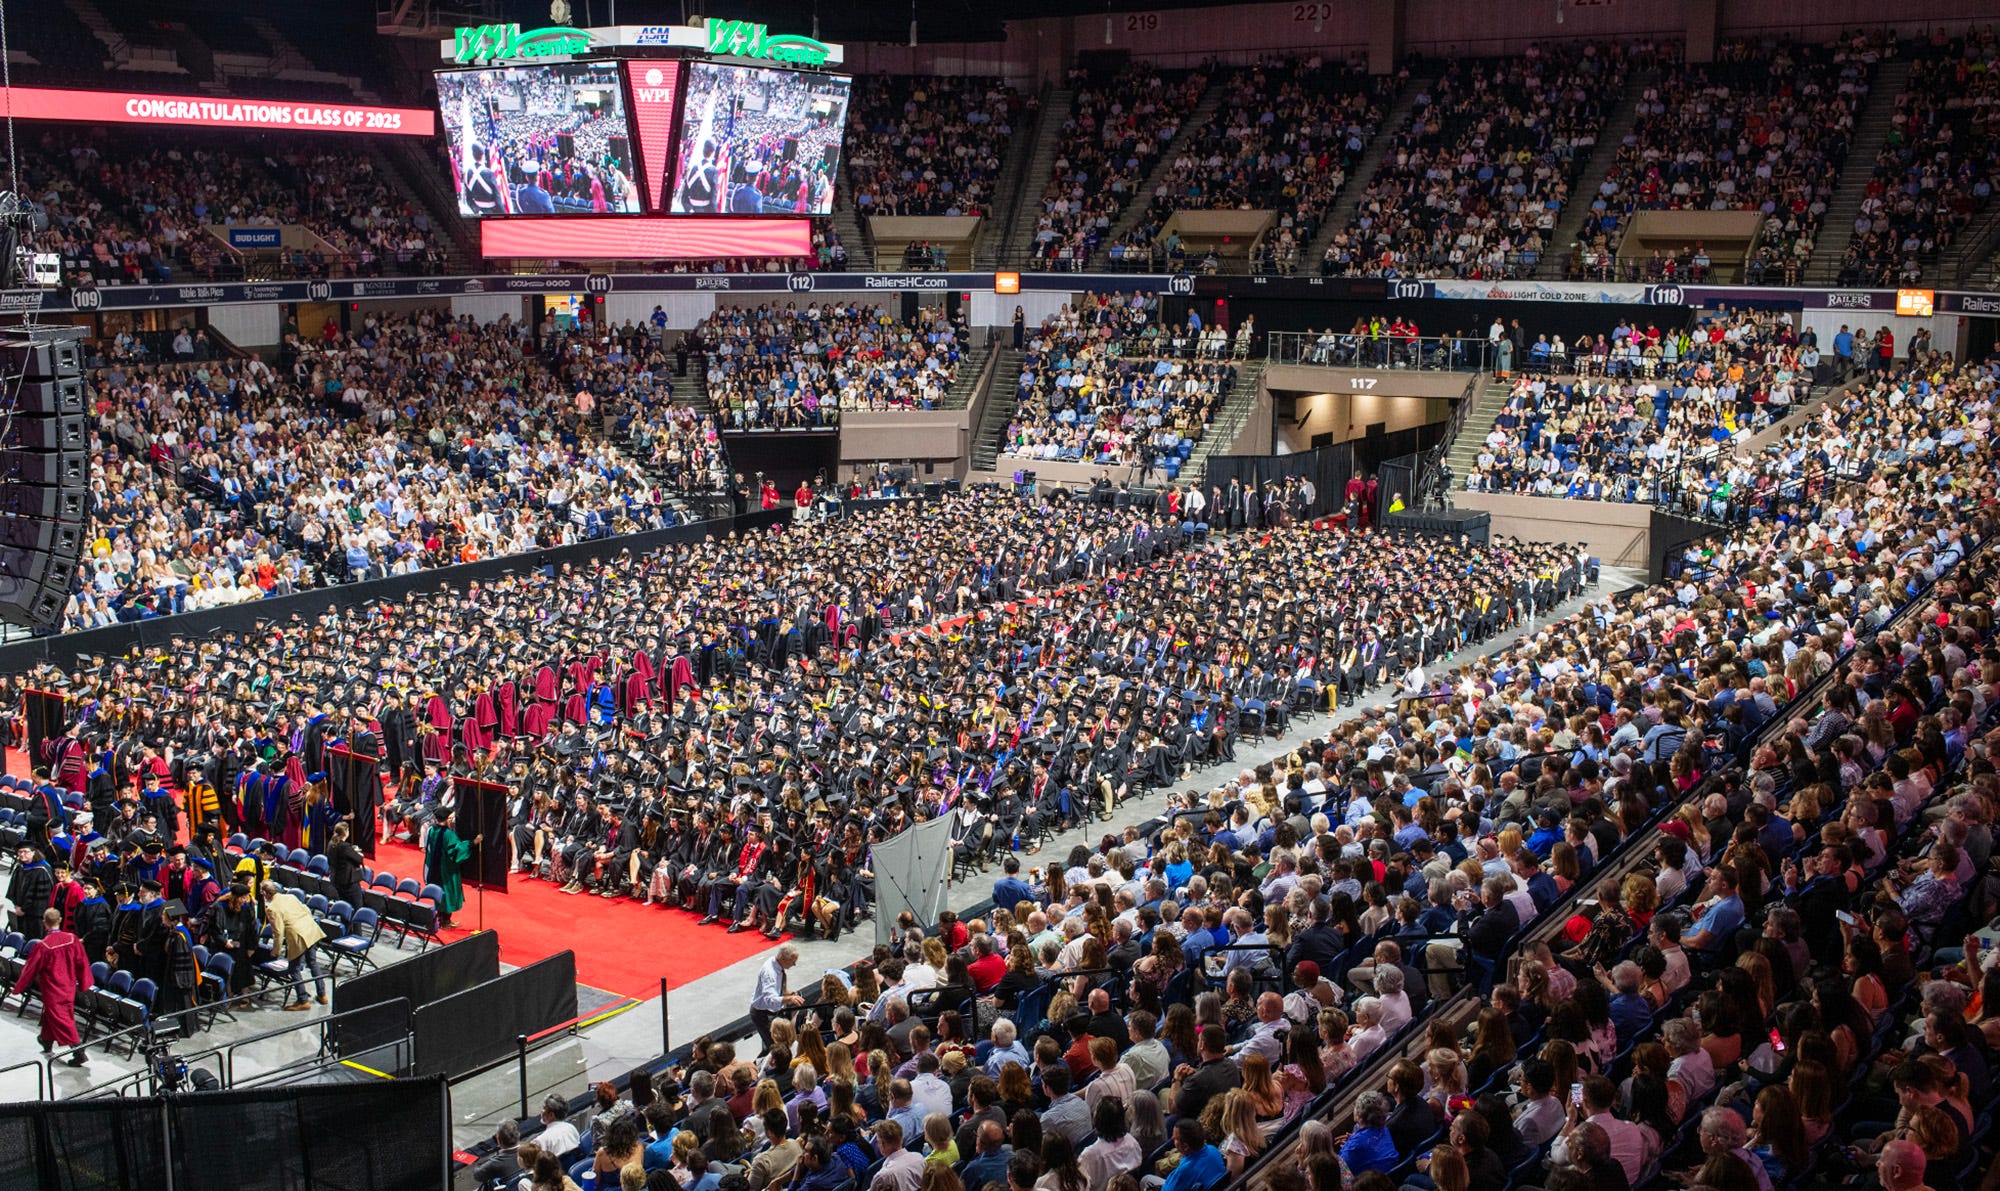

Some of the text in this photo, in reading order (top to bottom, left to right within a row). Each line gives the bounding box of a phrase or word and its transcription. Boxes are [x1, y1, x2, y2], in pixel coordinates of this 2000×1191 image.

[1127, 15, 1157, 30] 219
[639, 27, 670, 39] ASM
[455, 23, 589, 61] DCU center
[707, 18, 828, 65] DCU center
[637, 89, 670, 102] WPI
[126, 99, 401, 128] CONGRATULATIONS CLASS OF 2025
[235, 234, 275, 242] BUD LIGHT
[590, 278, 606, 290] 111
[696, 277, 729, 289] RAILERS
[791, 277, 810, 289] 112
[865, 277, 947, 287] RailersHC.com
[1173, 279, 1190, 291] 113
[311, 283, 328, 297] 110
[1400, 283, 1419, 297] 117
[1487, 287, 1514, 298] Coors
[1514, 291, 1537, 299] LIGHT
[1656, 289, 1678, 303] 118
[75, 291, 97, 307] 109
[1828, 293, 1871, 307] RAILERS
[1962, 297, 2000, 312] Railers
[1351, 378, 1377, 389] 117
